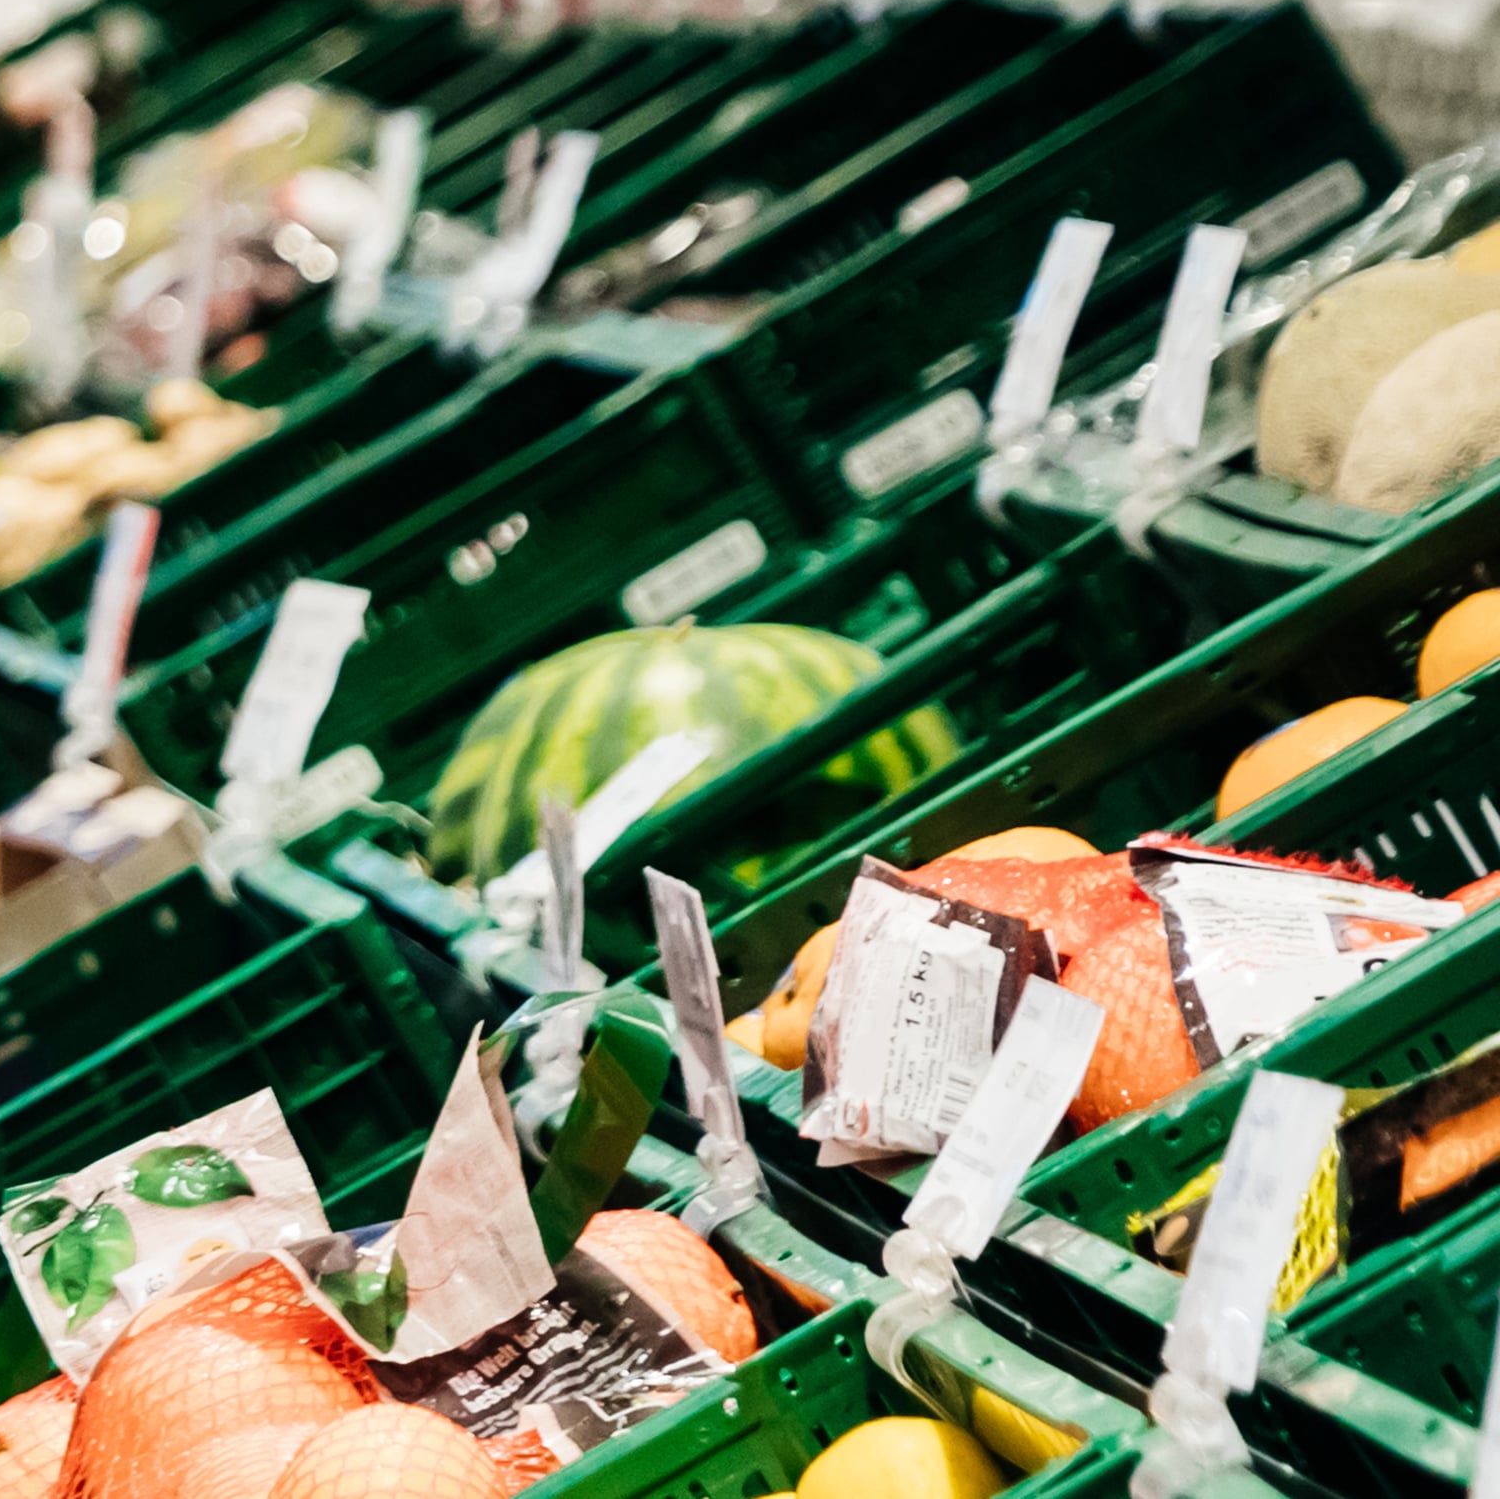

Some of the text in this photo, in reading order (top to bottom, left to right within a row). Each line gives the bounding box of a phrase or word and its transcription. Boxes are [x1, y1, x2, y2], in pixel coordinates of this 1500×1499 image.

[911, 950, 933, 982] kg
[905, 989, 925, 1026] 1.5
[447, 1369, 485, 1396] Die
[474, 1344, 521, 1379] Welt
[461, 1364, 534, 1413] bessere
